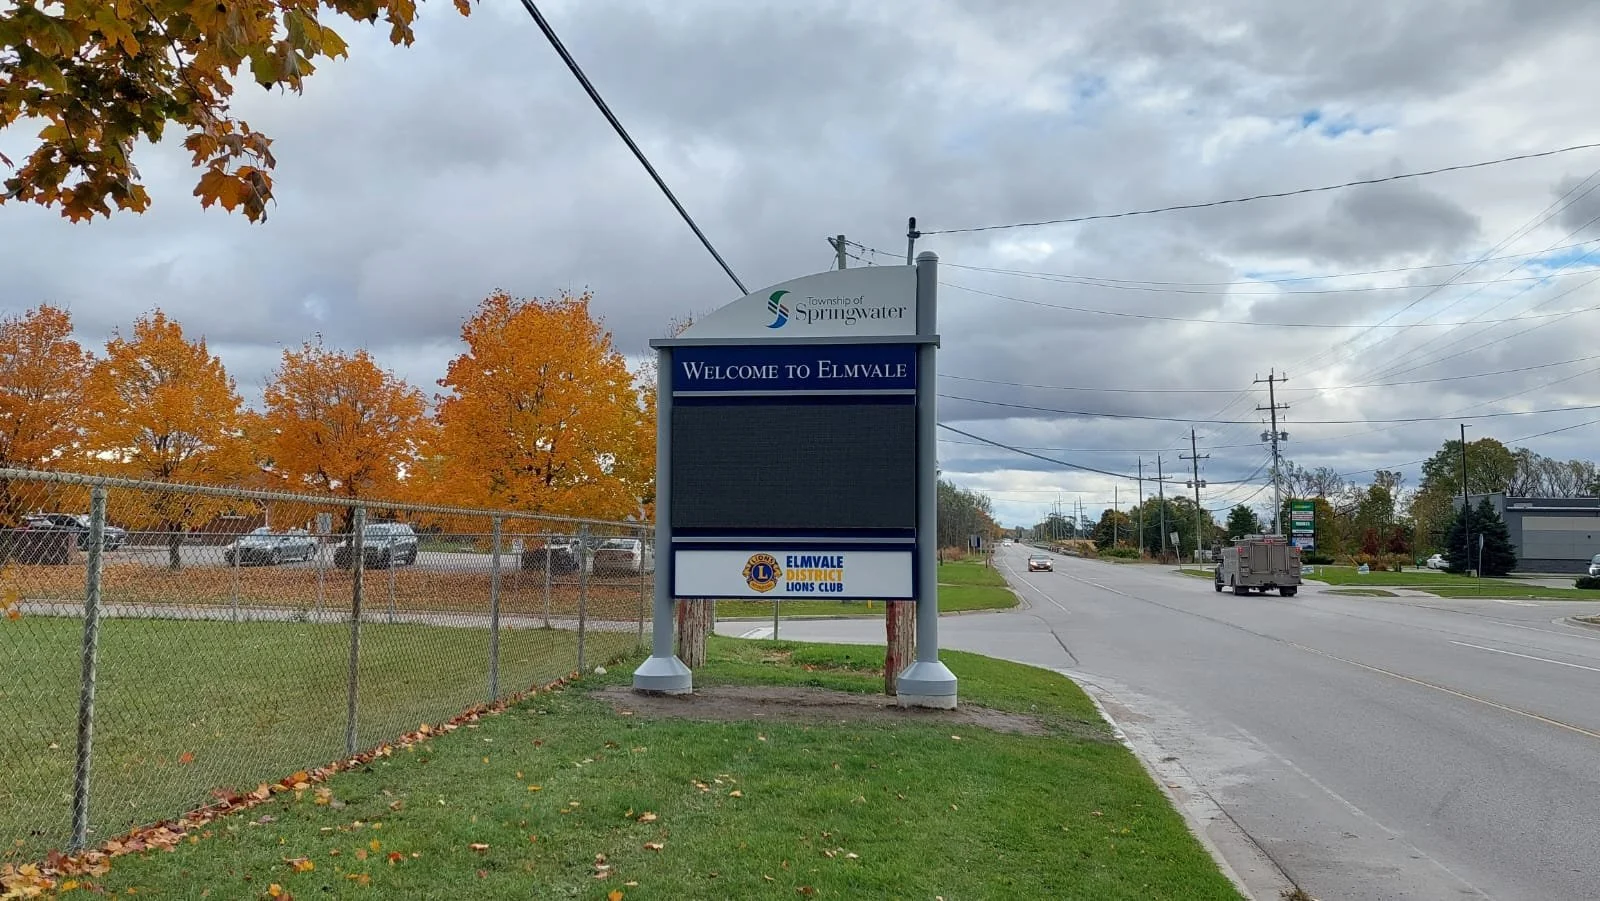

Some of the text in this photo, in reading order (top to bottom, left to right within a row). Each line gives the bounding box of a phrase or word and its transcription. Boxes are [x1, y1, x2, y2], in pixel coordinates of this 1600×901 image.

[807, 295, 864, 306] Township of
[795, 303, 907, 325] Springwater
[682, 360, 907, 379] WELCOME TO ELMVALE
[786, 555, 844, 568] ELMVALE
[758, 565, 768, 579] L
[786, 569, 844, 581] DISTRICT
[786, 582, 844, 592] LIONS CLUB
